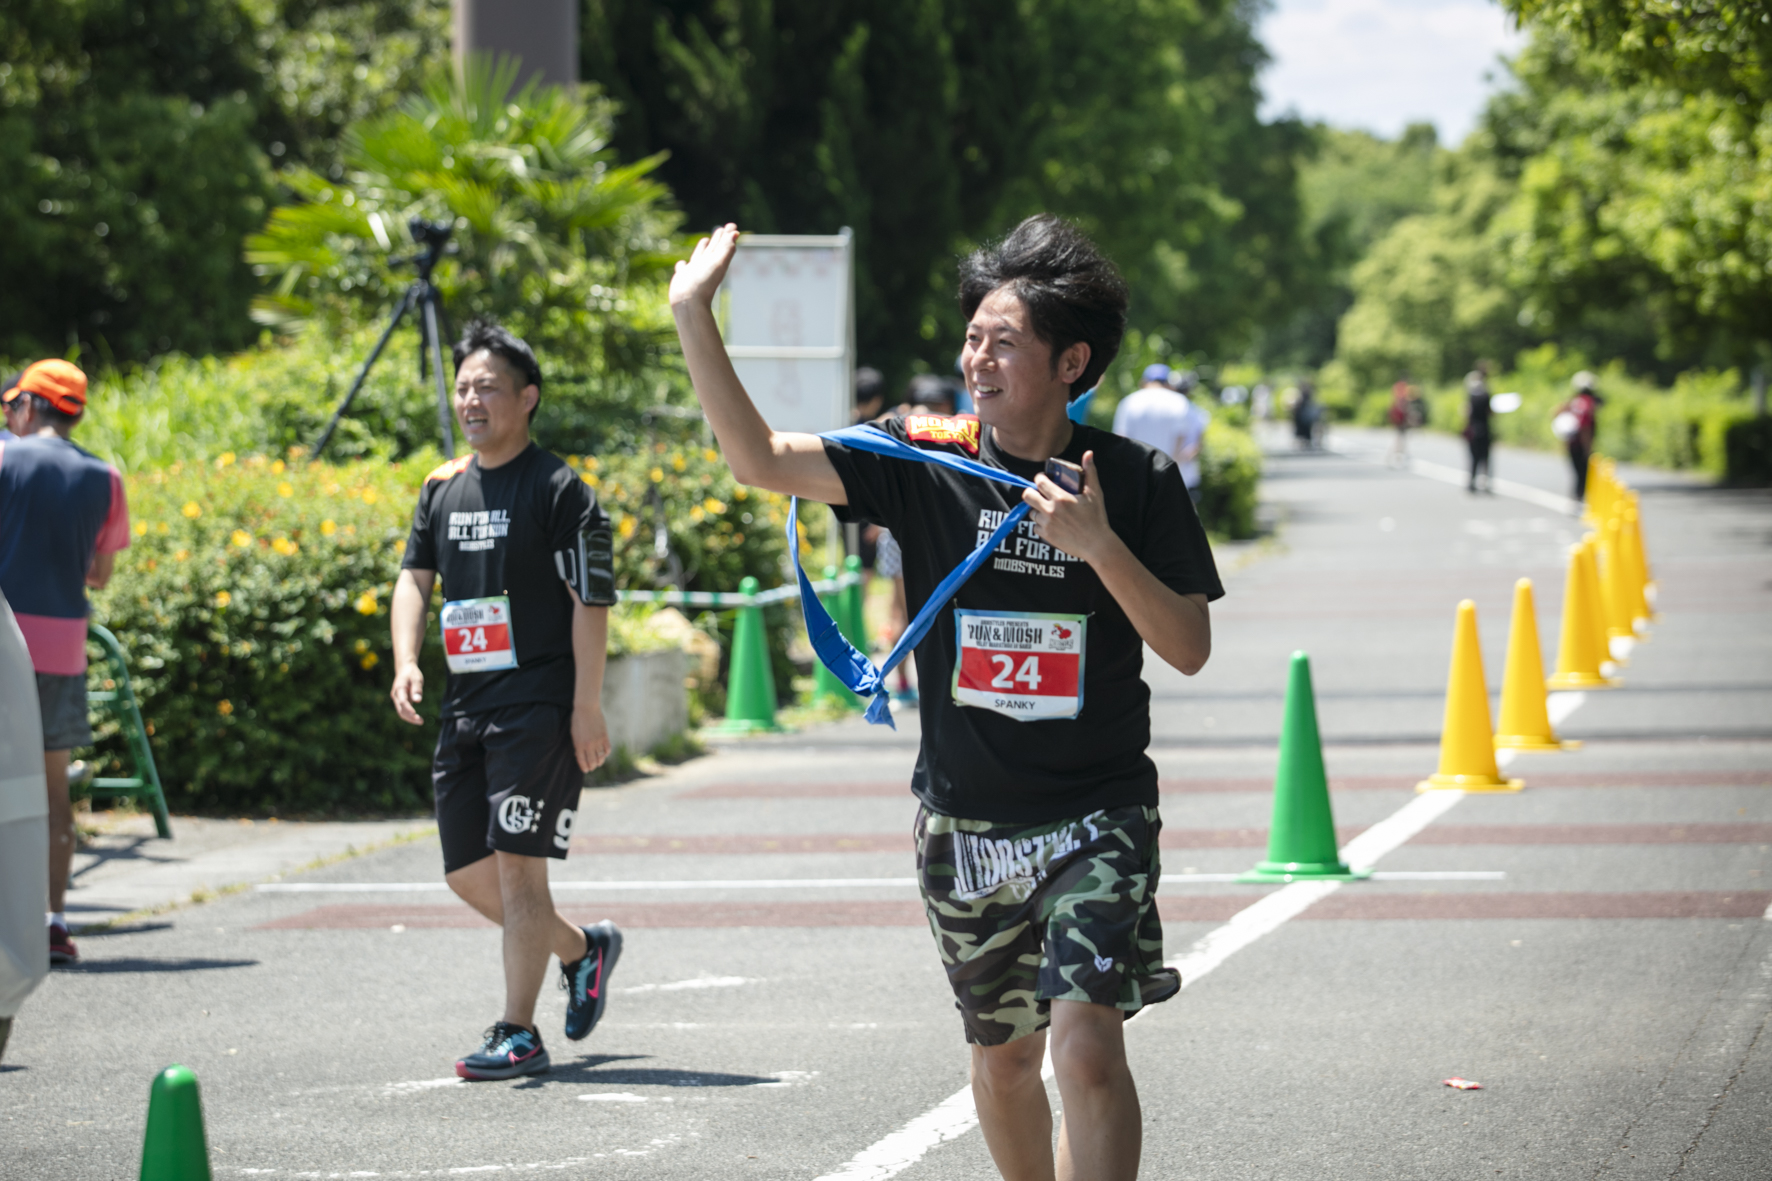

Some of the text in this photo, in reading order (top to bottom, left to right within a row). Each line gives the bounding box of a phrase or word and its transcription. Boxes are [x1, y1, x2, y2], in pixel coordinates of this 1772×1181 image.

[930, 430, 964, 442] TOKYO
[978, 509, 1039, 539] RU FO
[1015, 537, 1050, 560] FOR
[993, 557, 1065, 578] MOBSTYLES
[458, 626, 488, 652] 24
[991, 654, 1042, 690] 24
[995, 699, 1036, 710] SPANKY
